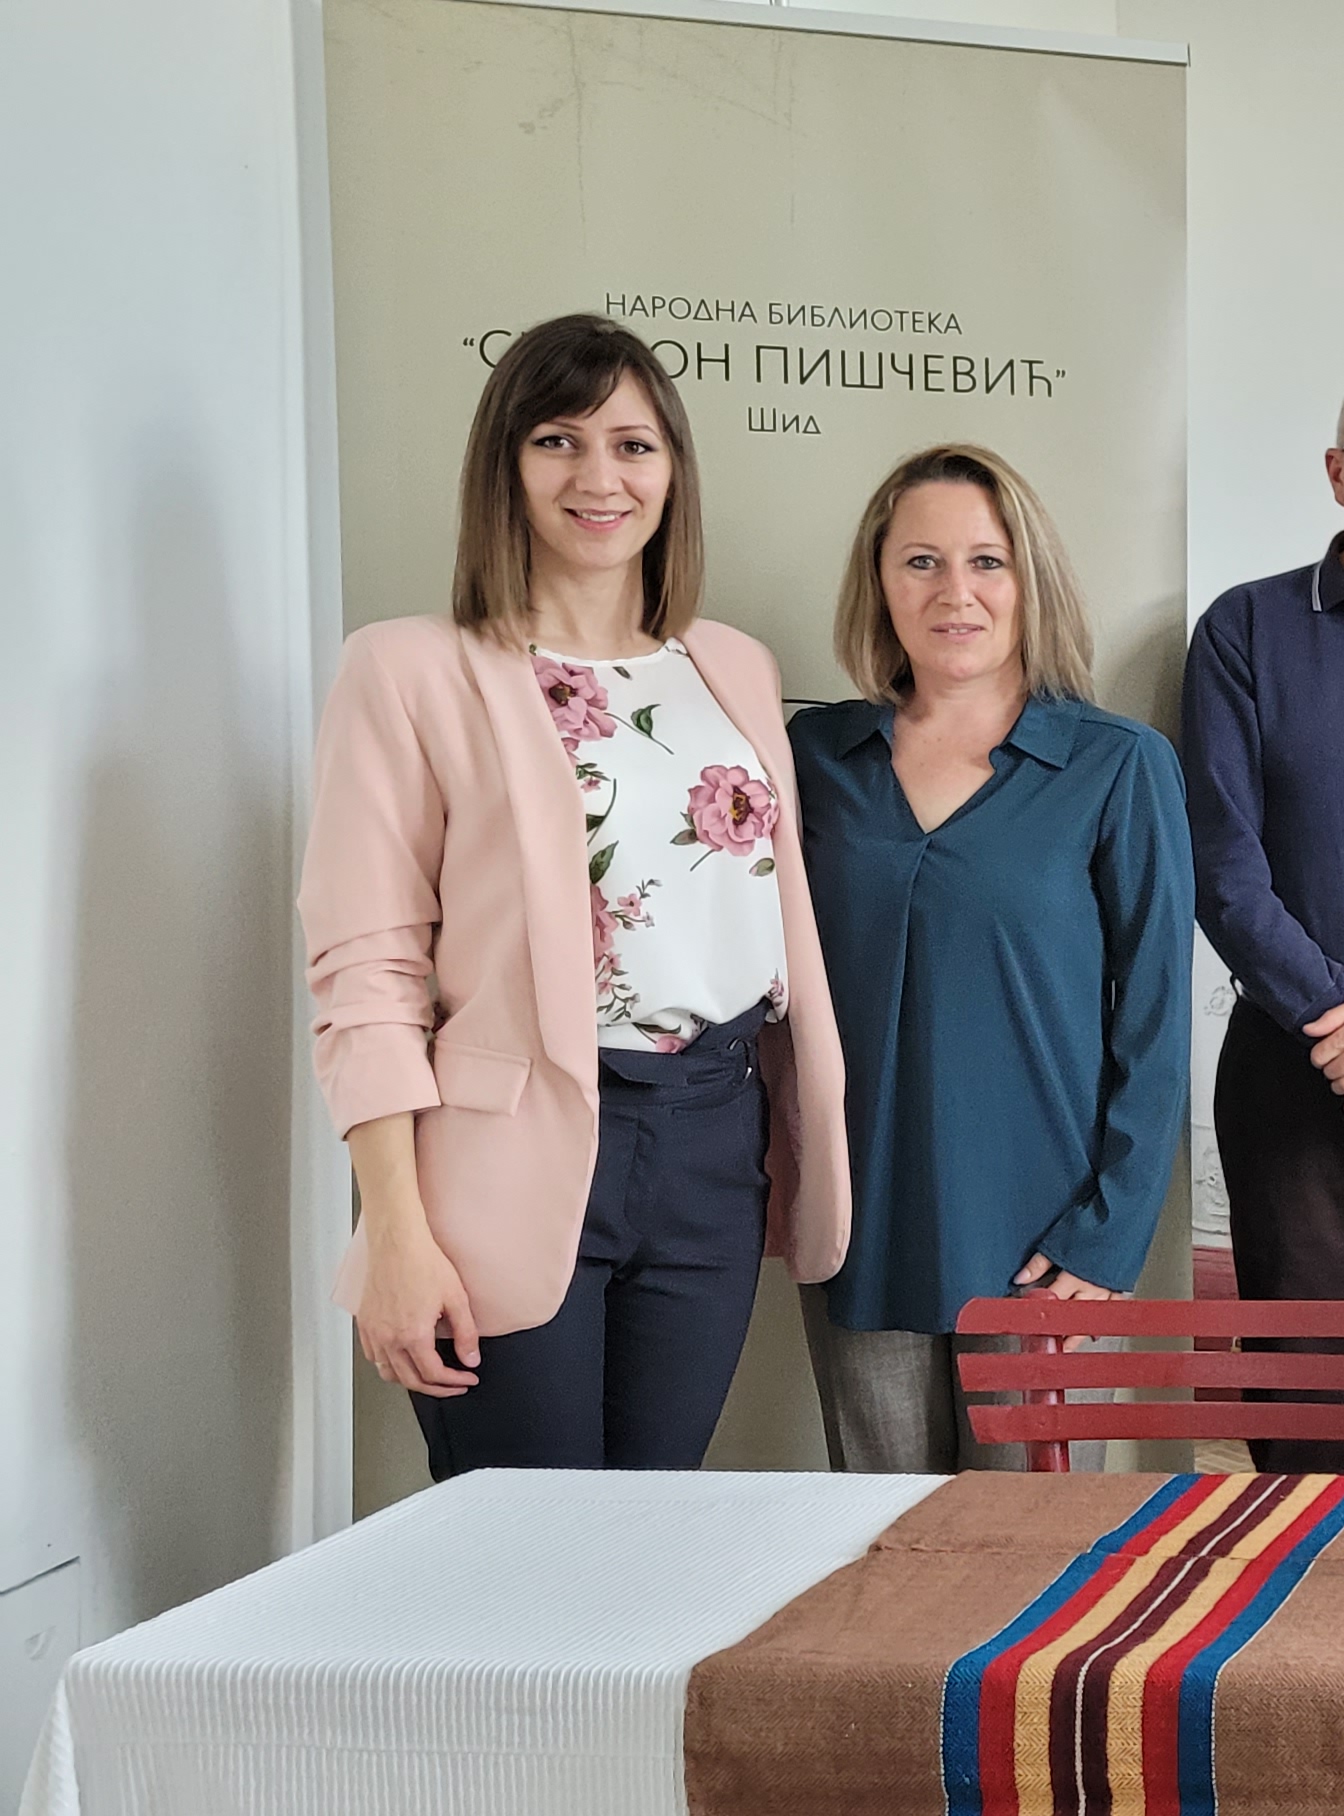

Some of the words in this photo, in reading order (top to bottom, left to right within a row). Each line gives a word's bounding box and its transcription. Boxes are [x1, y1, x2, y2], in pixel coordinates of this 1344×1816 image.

[605, 292, 758, 325] НАРОДНА
[768, 302, 963, 336] БИБЛИОТЕКА
[462, 329, 731, 382] “СОН
